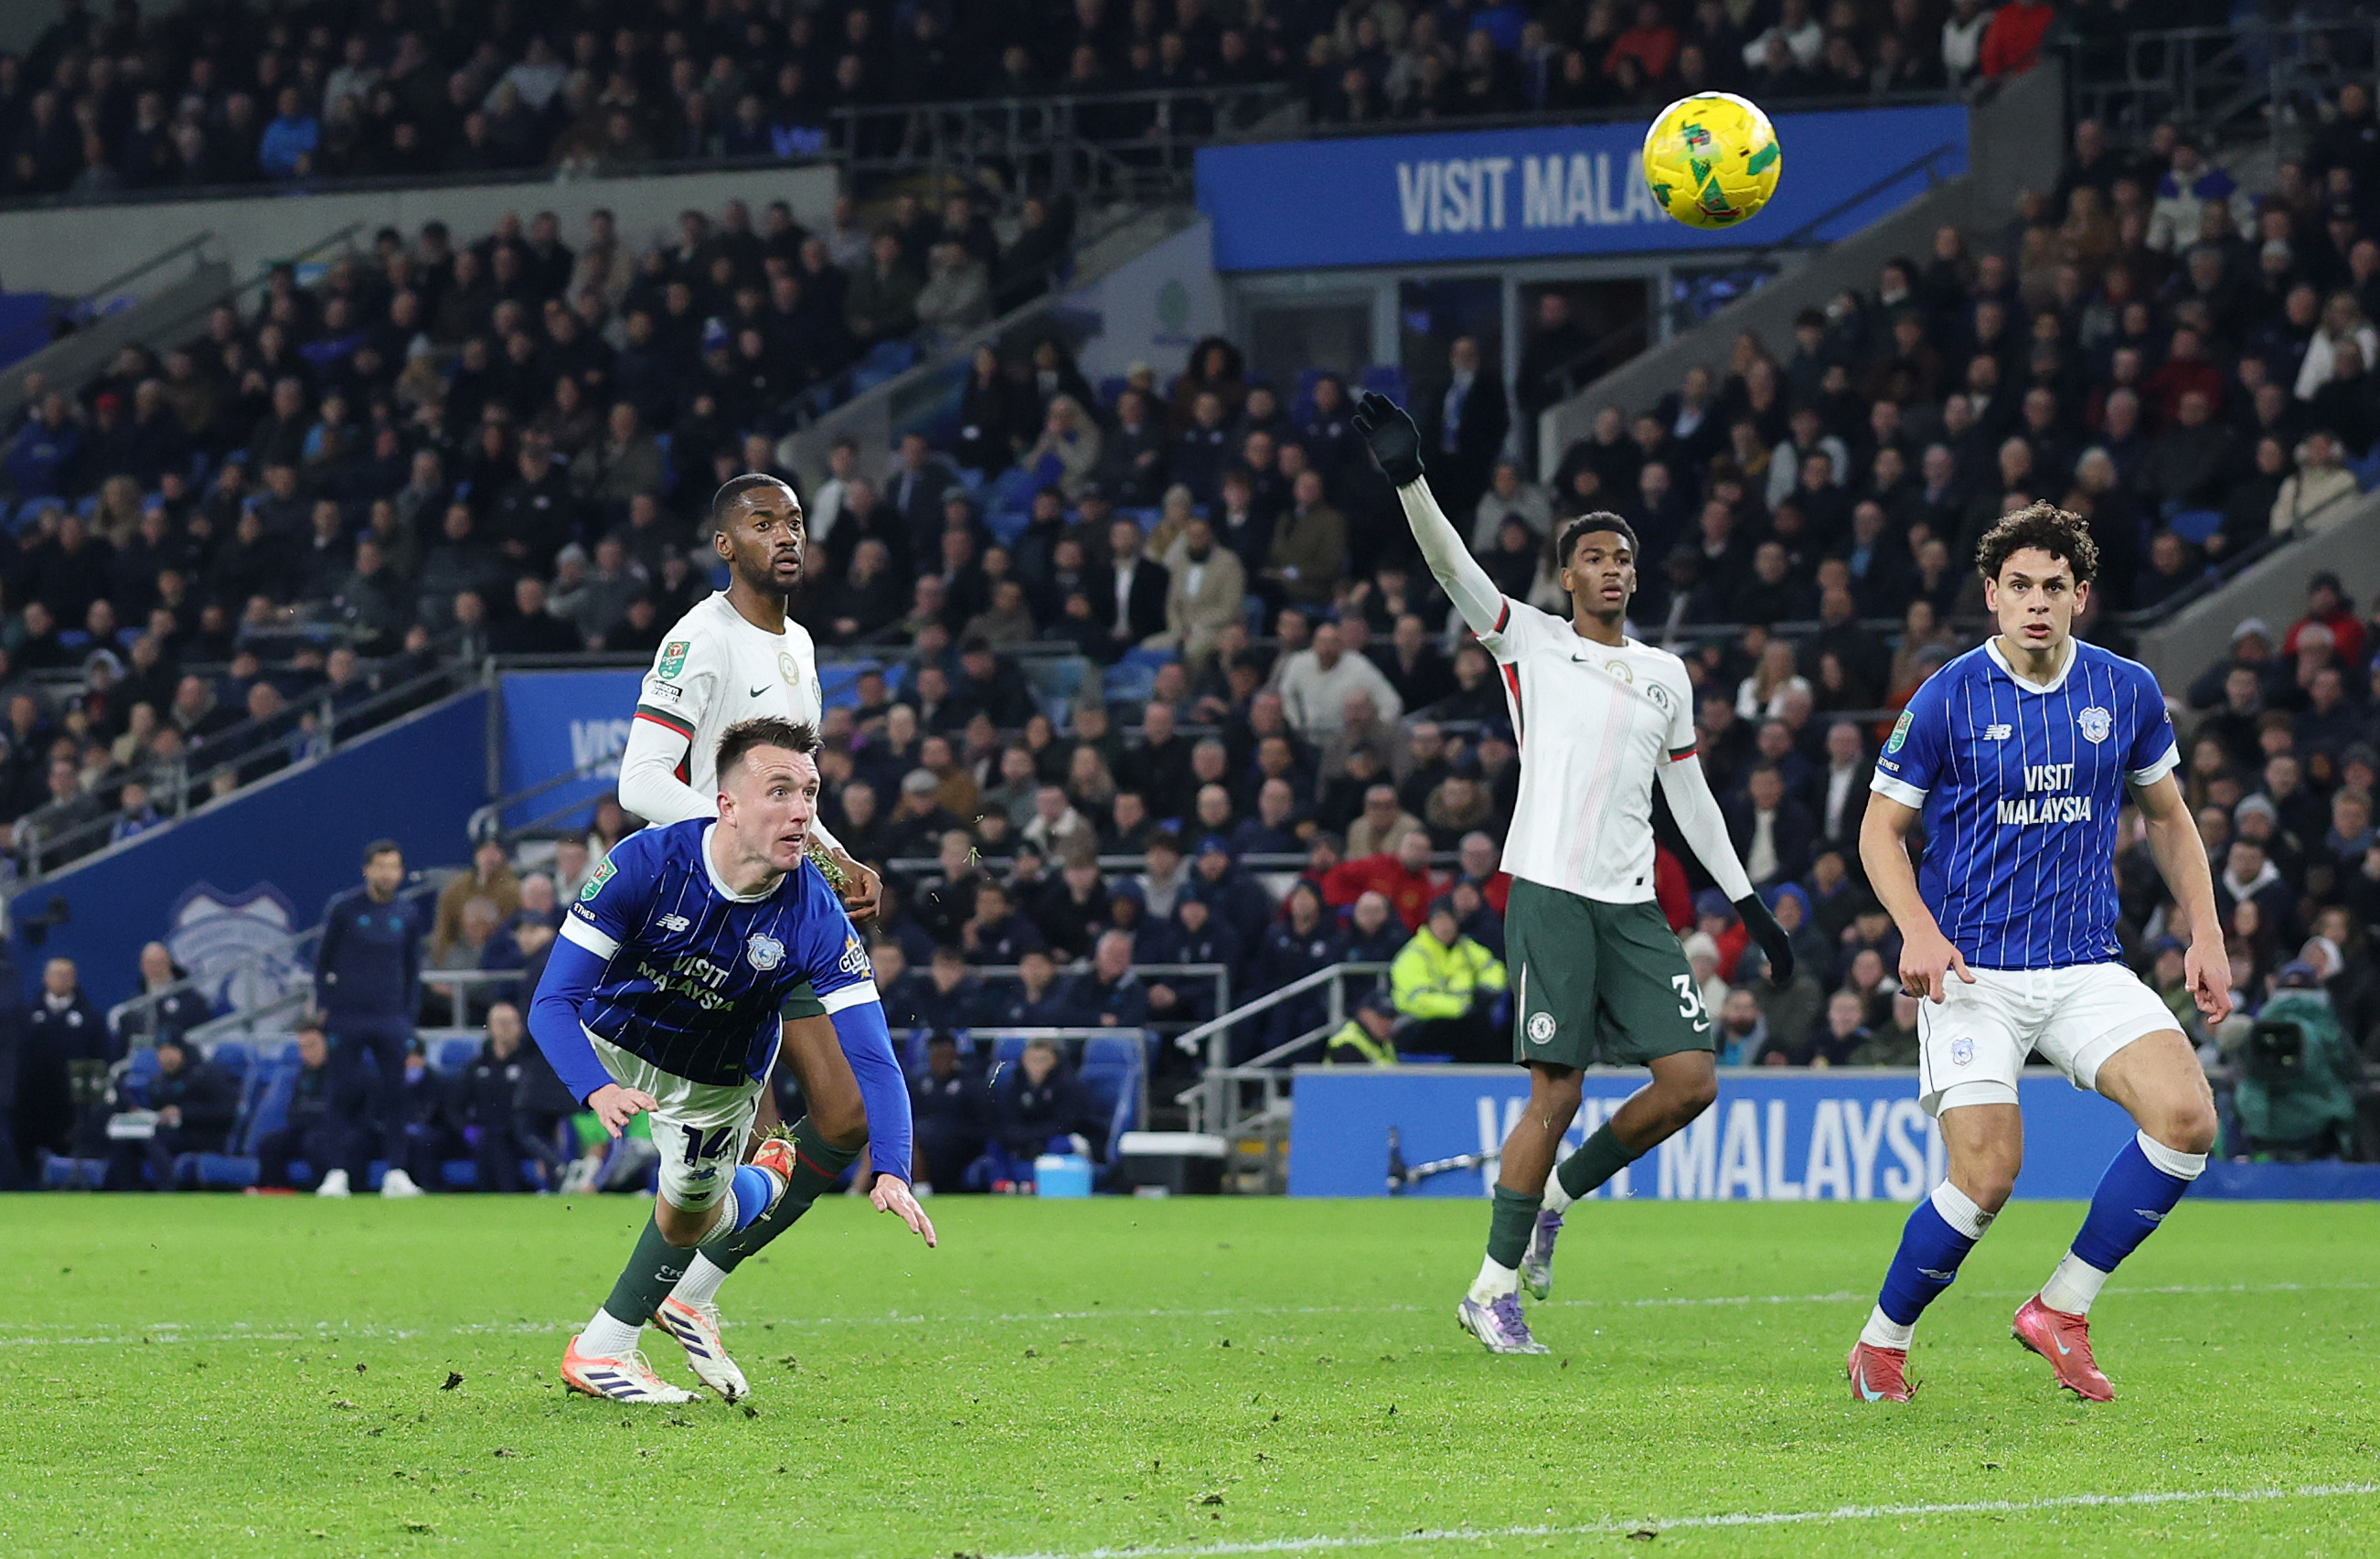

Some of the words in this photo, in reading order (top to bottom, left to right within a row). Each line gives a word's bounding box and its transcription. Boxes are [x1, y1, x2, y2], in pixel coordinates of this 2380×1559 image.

[1395, 156, 1512, 234] VISIT
[1521, 150, 1670, 227] MALA
[2023, 763, 2075, 793] VISIT
[1997, 796, 2092, 826] MALAYSIA
[636, 961, 735, 1012] MALAYSIA
[672, 956, 730, 989] VISIT
